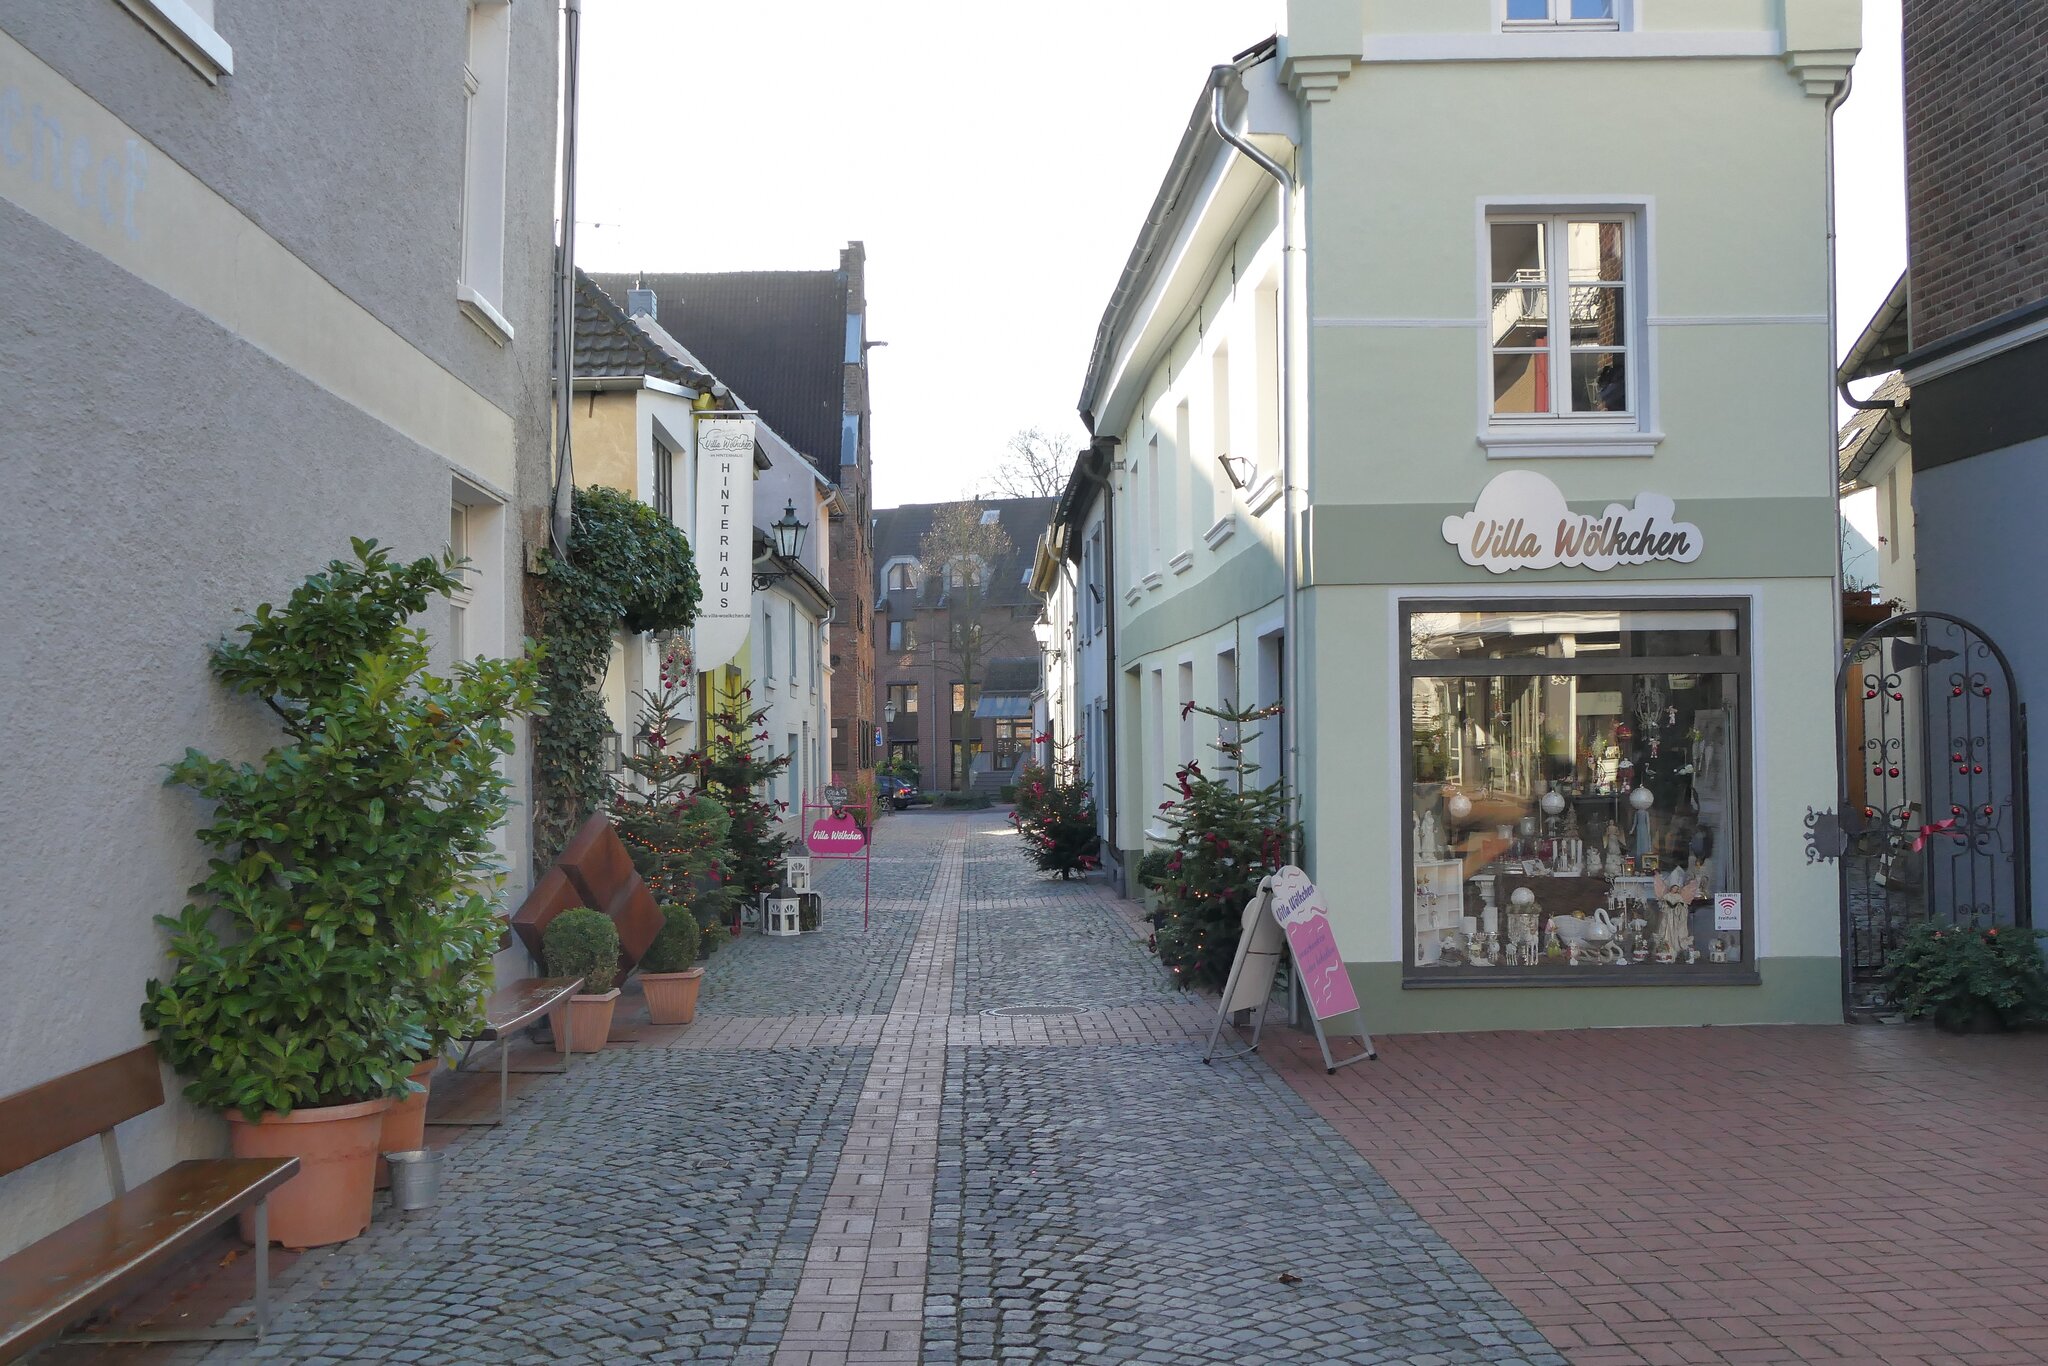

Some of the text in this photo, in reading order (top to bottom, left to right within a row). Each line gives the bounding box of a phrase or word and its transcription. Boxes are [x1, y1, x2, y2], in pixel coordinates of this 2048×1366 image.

[720, 463, 730, 608] HINTERHAUS
[1471, 516, 1691, 558] Villa Wölkchen
[813, 831, 862, 840] Villa Wölkchen
[1276, 884, 1315, 921] Villa Wölkchen
